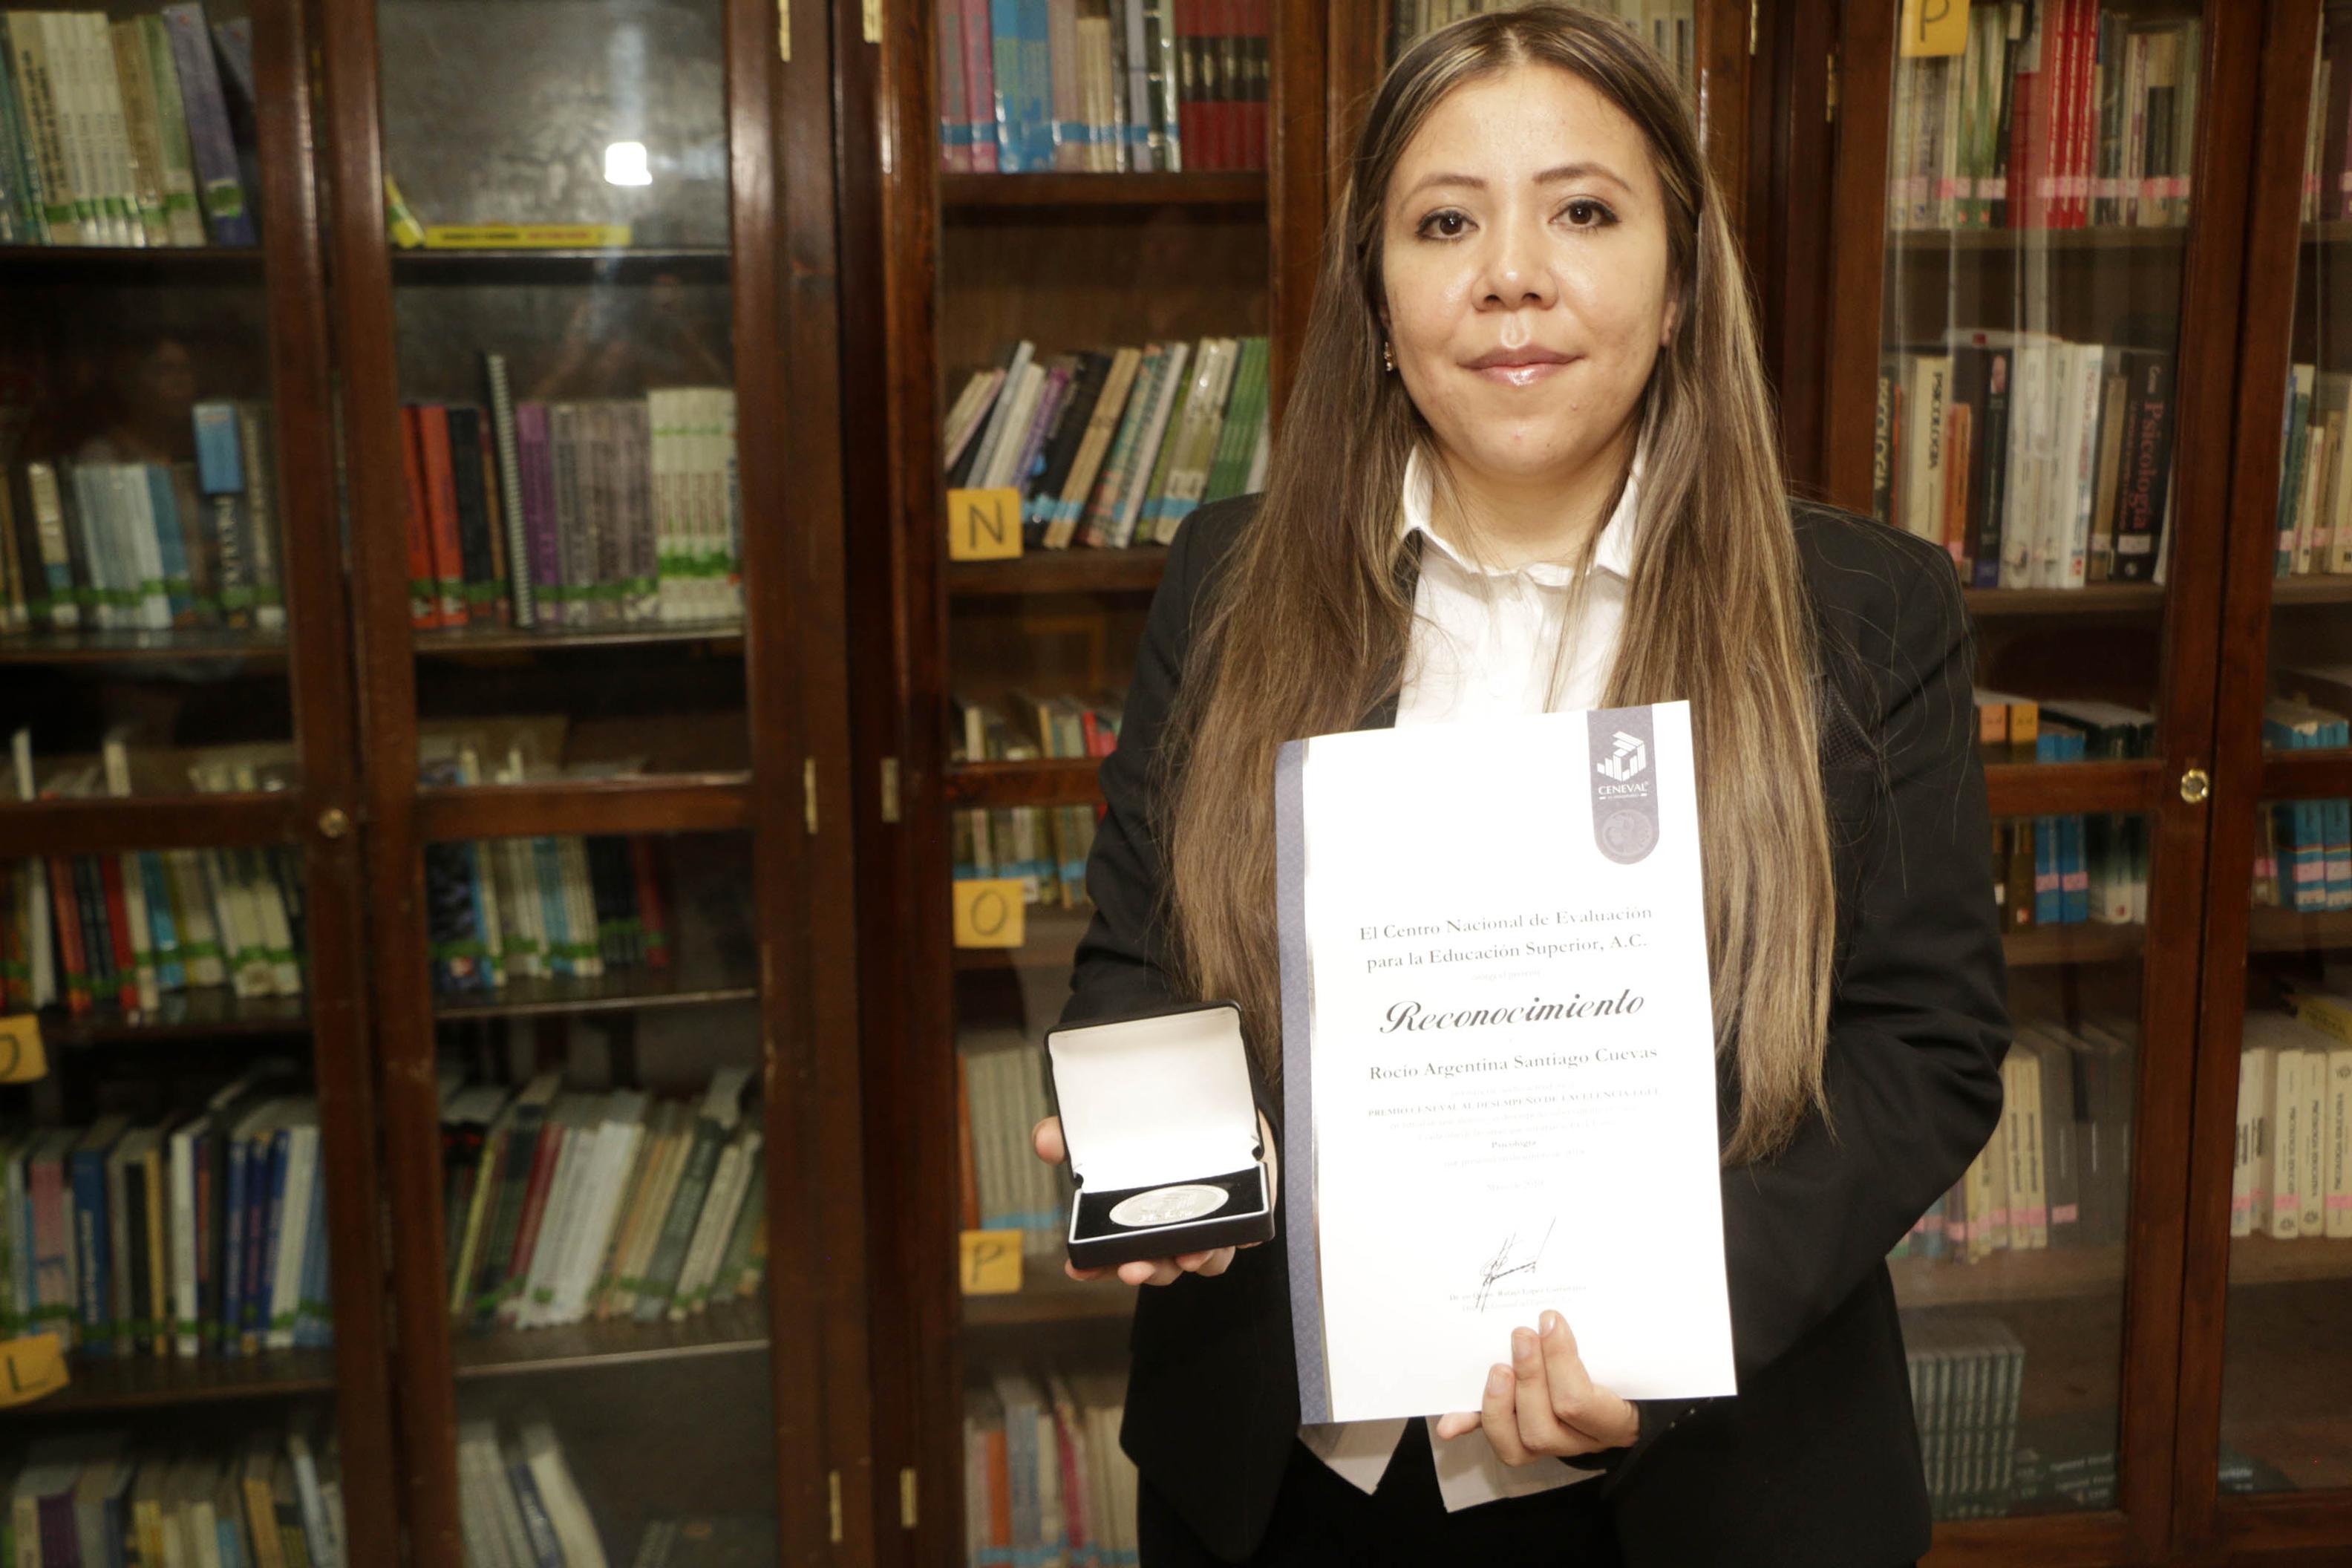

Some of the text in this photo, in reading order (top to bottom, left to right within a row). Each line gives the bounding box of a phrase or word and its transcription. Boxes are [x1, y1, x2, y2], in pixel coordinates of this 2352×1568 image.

[1920, 0, 1950, 42] P
[968, 500, 1004, 549] N
[1598, 783, 1647, 795] CENEVAL
[970, 888, 1007, 936] O
[1360, 906, 1653, 941] El Centro Nacional de Evaluación
[1367, 933, 1648, 973] para la Educación Superior, A.C.
[1379, 988, 1645, 1033] Reconocimiento
[1424, 1057, 1509, 1079] Argentina
[1514, 1052, 1590, 1069] Santiago
[1595, 1048, 1658, 1063] Cuevas
[971, 1241, 1006, 1284] P
